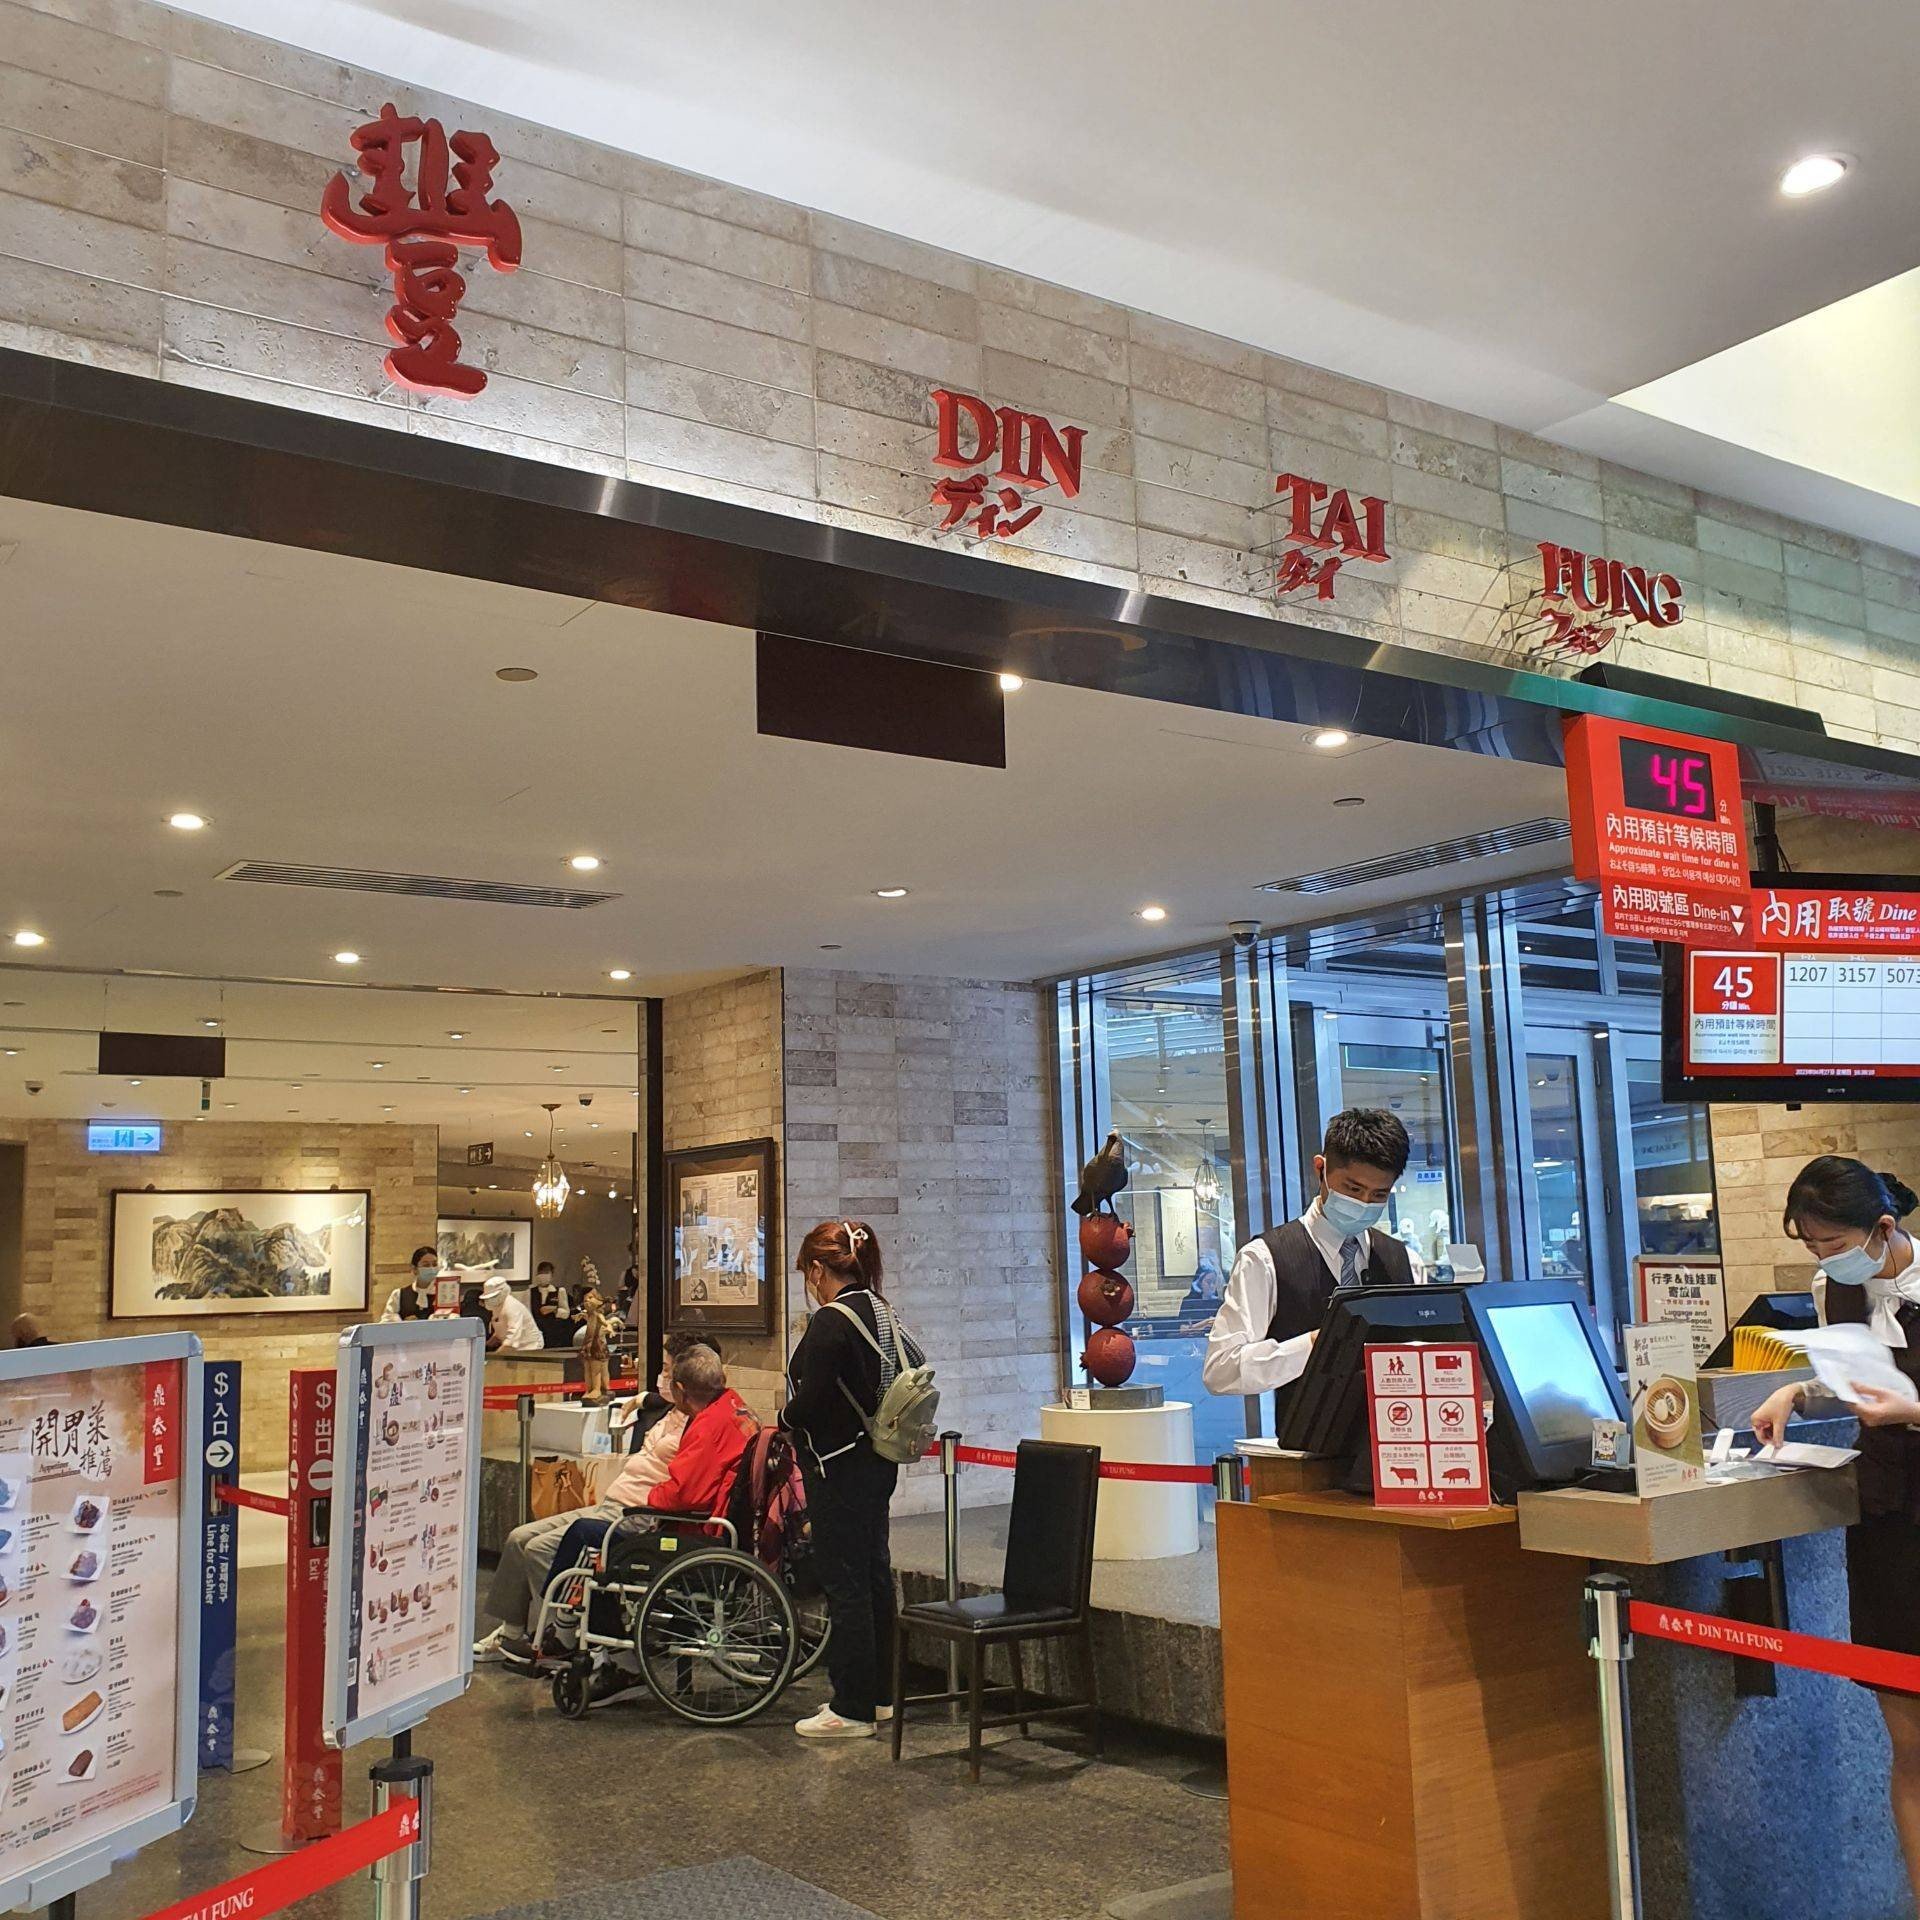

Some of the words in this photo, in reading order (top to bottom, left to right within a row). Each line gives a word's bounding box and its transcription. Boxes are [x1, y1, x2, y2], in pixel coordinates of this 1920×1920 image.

[931, 473, 1044, 539] ディン
[931, 388, 1089, 499] DIN
[1275, 472, 1392, 563] TAI
[1537, 541, 1686, 628] FUNG
[1651, 753, 1707, 815] 45
[1608, 842, 1662, 859] Approximate
[1662, 850, 1681, 862] wait
[1681, 853, 1700, 865] time
[1700, 857, 1713, 866] for
[1713, 857, 1730, 869] dine
[1731, 860, 1740, 870] in
[1692, 903, 1731, 922] Dine-in
[1878, 903, 1917, 921] Dine
[1713, 966, 1754, 998] 45
[1789, 967, 1827, 982] 1207
[1838, 967, 1876, 983] 3157
[1663, 1309, 1693, 1317] Luggage
[213, 1371, 229, 1397] $
[315, 1380, 332, 1411] $
[31, 1399, 110, 1458] 開胃菜
[212, 1402, 229, 1436] 入口
[314, 1418, 332, 1455] 出口
[39, 1461, 70, 1475] Appetizer
[78, 1446, 113, 1478] 推薦
[206, 1524, 217, 1547] Line
[206, 1548, 217, 1564] for
[308, 1558, 320, 1581] Exit
[205, 1565, 217, 1605] Cashier
[1697, 1623, 1722, 1640] DIN
[1723, 1627, 1745, 1645] TAI
[1746, 1632, 1783, 1653] FUNG
[209, 1887, 255, 1919] FUNG
